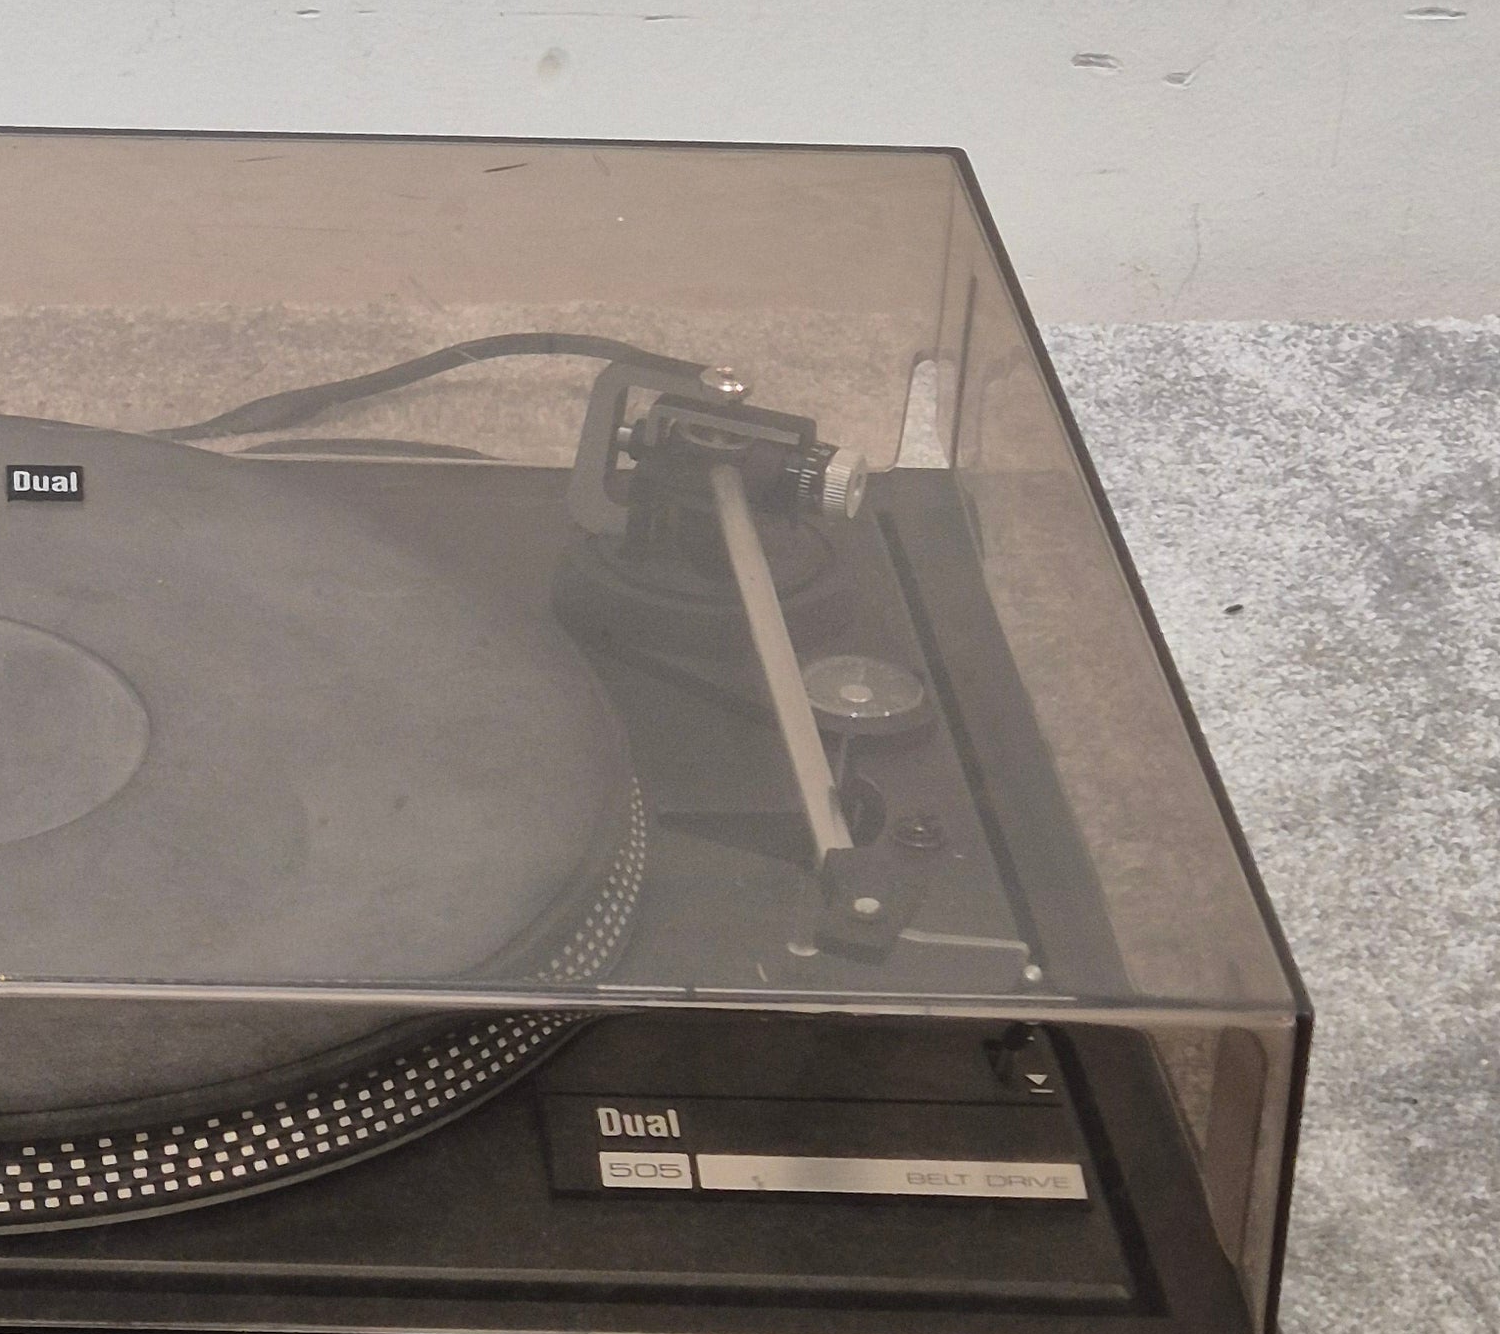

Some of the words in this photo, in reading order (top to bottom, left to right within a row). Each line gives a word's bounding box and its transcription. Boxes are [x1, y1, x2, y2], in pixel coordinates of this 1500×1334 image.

[13, 470, 78, 493] Dual
[597, 1107, 681, 1138] Dual
[609, 1162, 683, 1179] 505
[906, 1172, 969, 1186] BELT
[985, 1174, 1070, 1189] DRIVE
